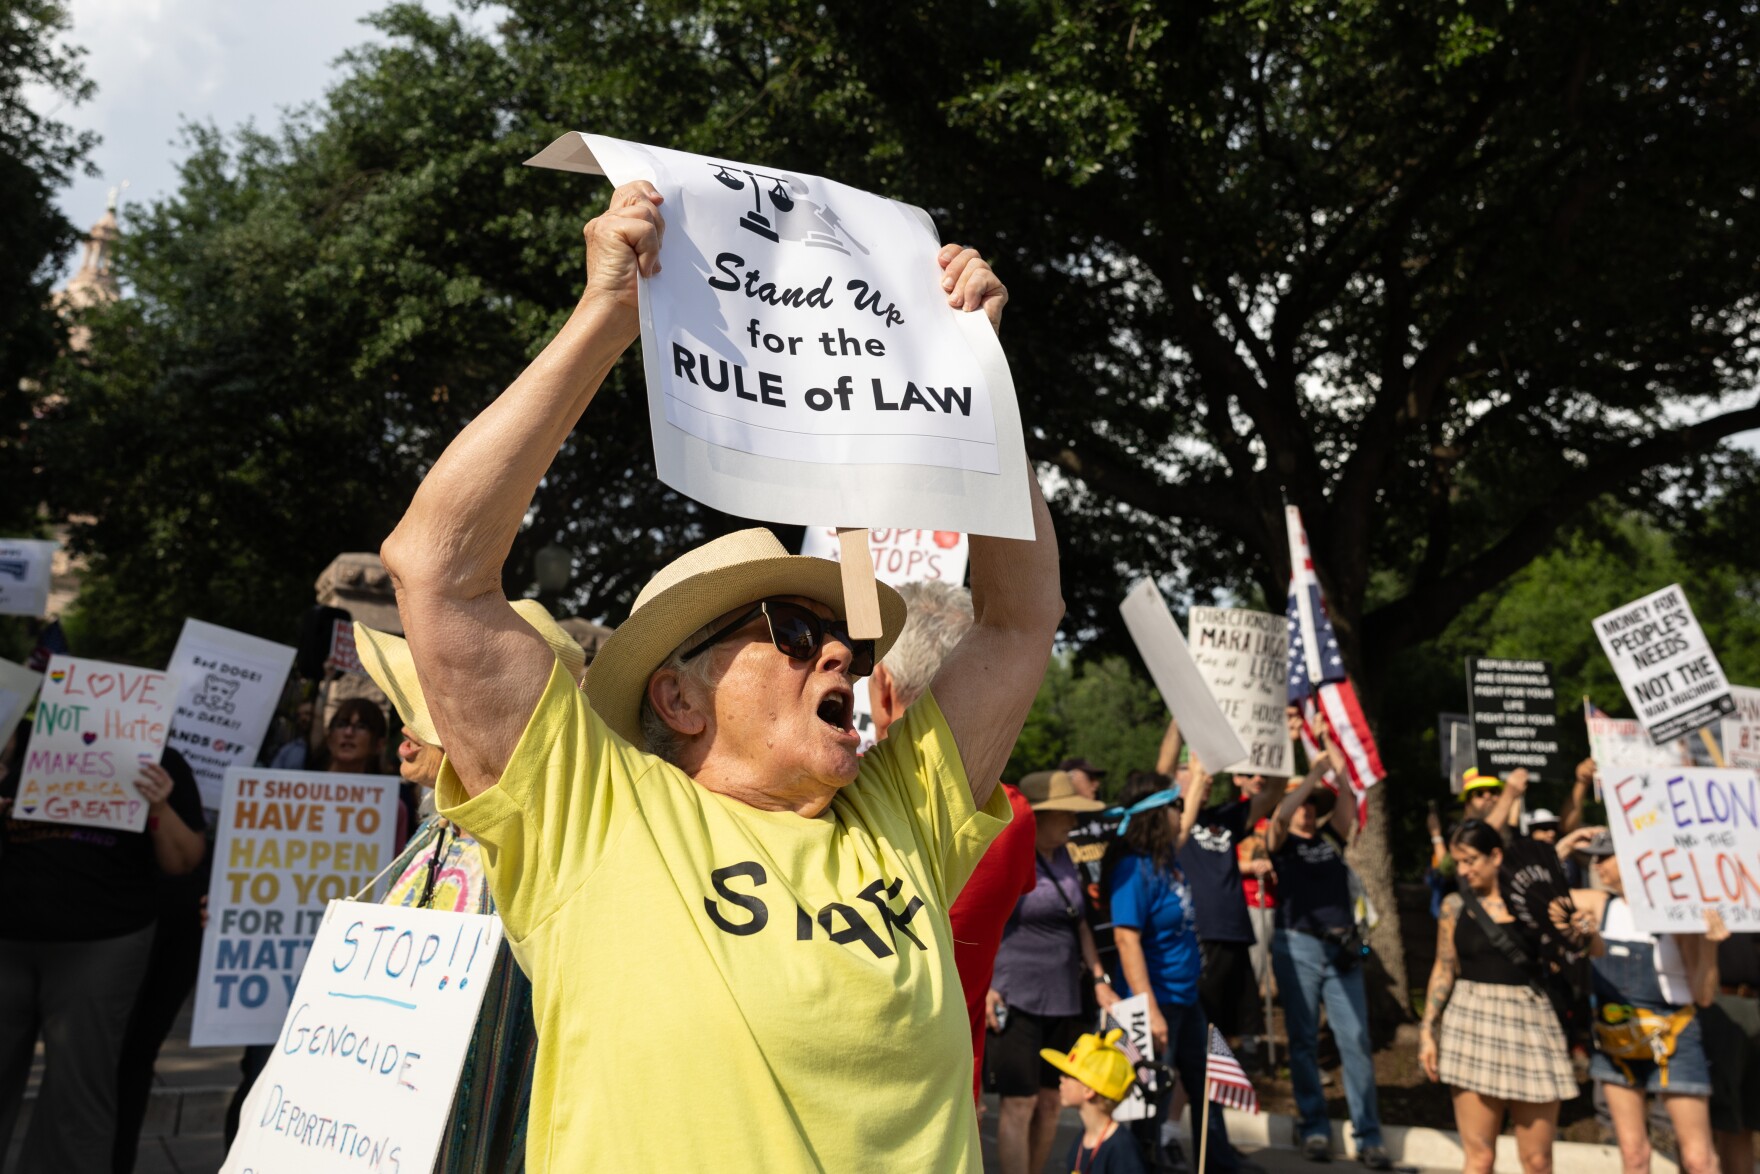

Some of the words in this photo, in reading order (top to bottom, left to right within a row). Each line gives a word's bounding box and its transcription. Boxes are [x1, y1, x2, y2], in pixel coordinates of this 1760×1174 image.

[708, 252, 833, 310] Stand
[847, 279, 905, 327] Up
[747, 319, 803, 357] for
[819, 328, 885, 357] the
[672, 342, 786, 408] RULE
[804, 376, 853, 411] of
[872, 378, 971, 416] LAW
[1603, 603, 1650, 635] MONEY
[1653, 591, 1679, 613] FOR
[1610, 609, 1689, 656] PEOPLE'S
[1477, 659, 1545, 672] REPUBLICANS
[1632, 632, 1689, 670] NEEDS
[1474, 685, 1504, 697] FIGHT
[1505, 687, 1525, 698] FOR
[1526, 688, 1554, 699] YOUR
[1475, 672, 1494, 683] ARE
[1495, 673, 1550, 686] CRIMINALS
[1634, 672, 1675, 704] NOT
[1676, 655, 1714, 685] THE
[36, 702, 89, 736] NOT
[1475, 712, 1504, 724] FIGHT
[1506, 713, 1526, 724] FOR
[1528, 714, 1555, 726] YOUR
[1503, 700, 1525, 711] LIFE
[169, 728, 210, 747] ANDS
[1478, 739, 1507, 750] FIGHT
[1508, 740, 1529, 751] FOR
[1530, 741, 1558, 753] YOUR
[1496, 726, 1537, 738] LIBERTY
[27, 751, 115, 778] MAKES
[1491, 753, 1547, 766] HAPPINESS
[237, 778, 259, 797] IT
[264, 780, 385, 804] SHOULDN'T
[1667, 776, 1759, 829] ELON
[234, 802, 323, 832] HAVE
[336, 807, 381, 835] TO
[228, 838, 380, 872] HAPPEN
[226, 873, 280, 904] TO
[292, 875, 376, 905] YOU
[221, 909, 284, 935] FOR
[216, 939, 314, 970] MAT
[333, 921, 483, 990] STOP!!
[214, 974, 270, 1009] TO
[283, 1003, 421, 1092] GENOCIDE
[260, 1085, 402, 1174] DEPORTATIONS
